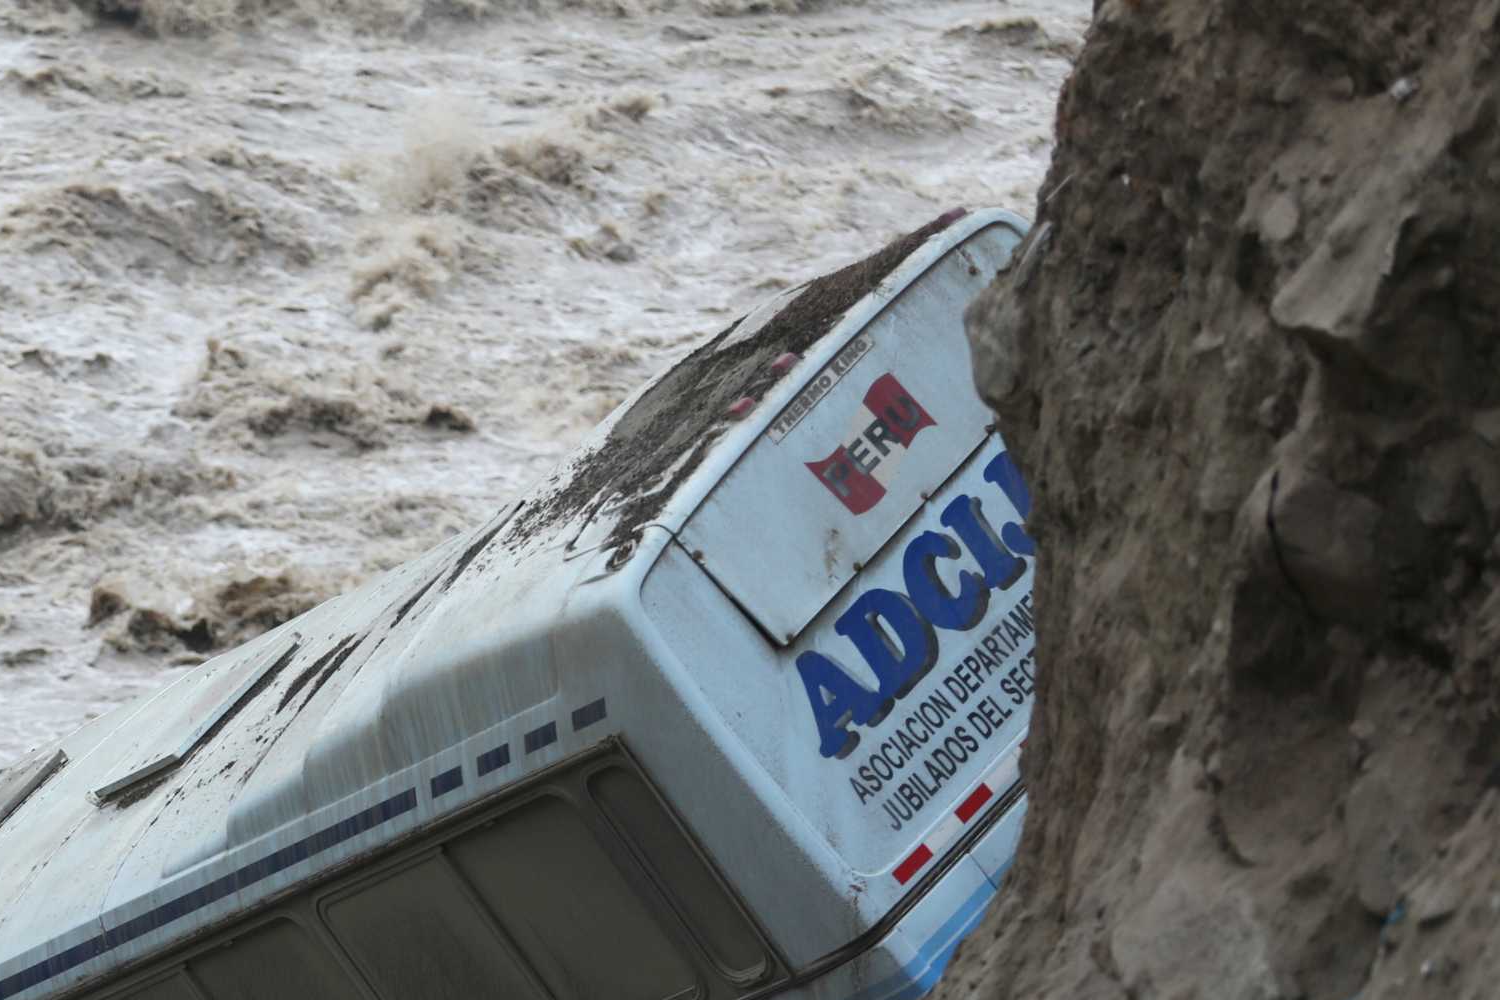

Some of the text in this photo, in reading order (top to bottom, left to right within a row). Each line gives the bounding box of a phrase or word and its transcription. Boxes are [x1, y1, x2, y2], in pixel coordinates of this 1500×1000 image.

[772, 338, 869, 434] THERMO KING
[822, 395, 921, 497] PERU
[849, 589, 1035, 805] ASOCIACION DEPARTAME
[881, 647, 1035, 832] JUBILADOS DEL SEC
